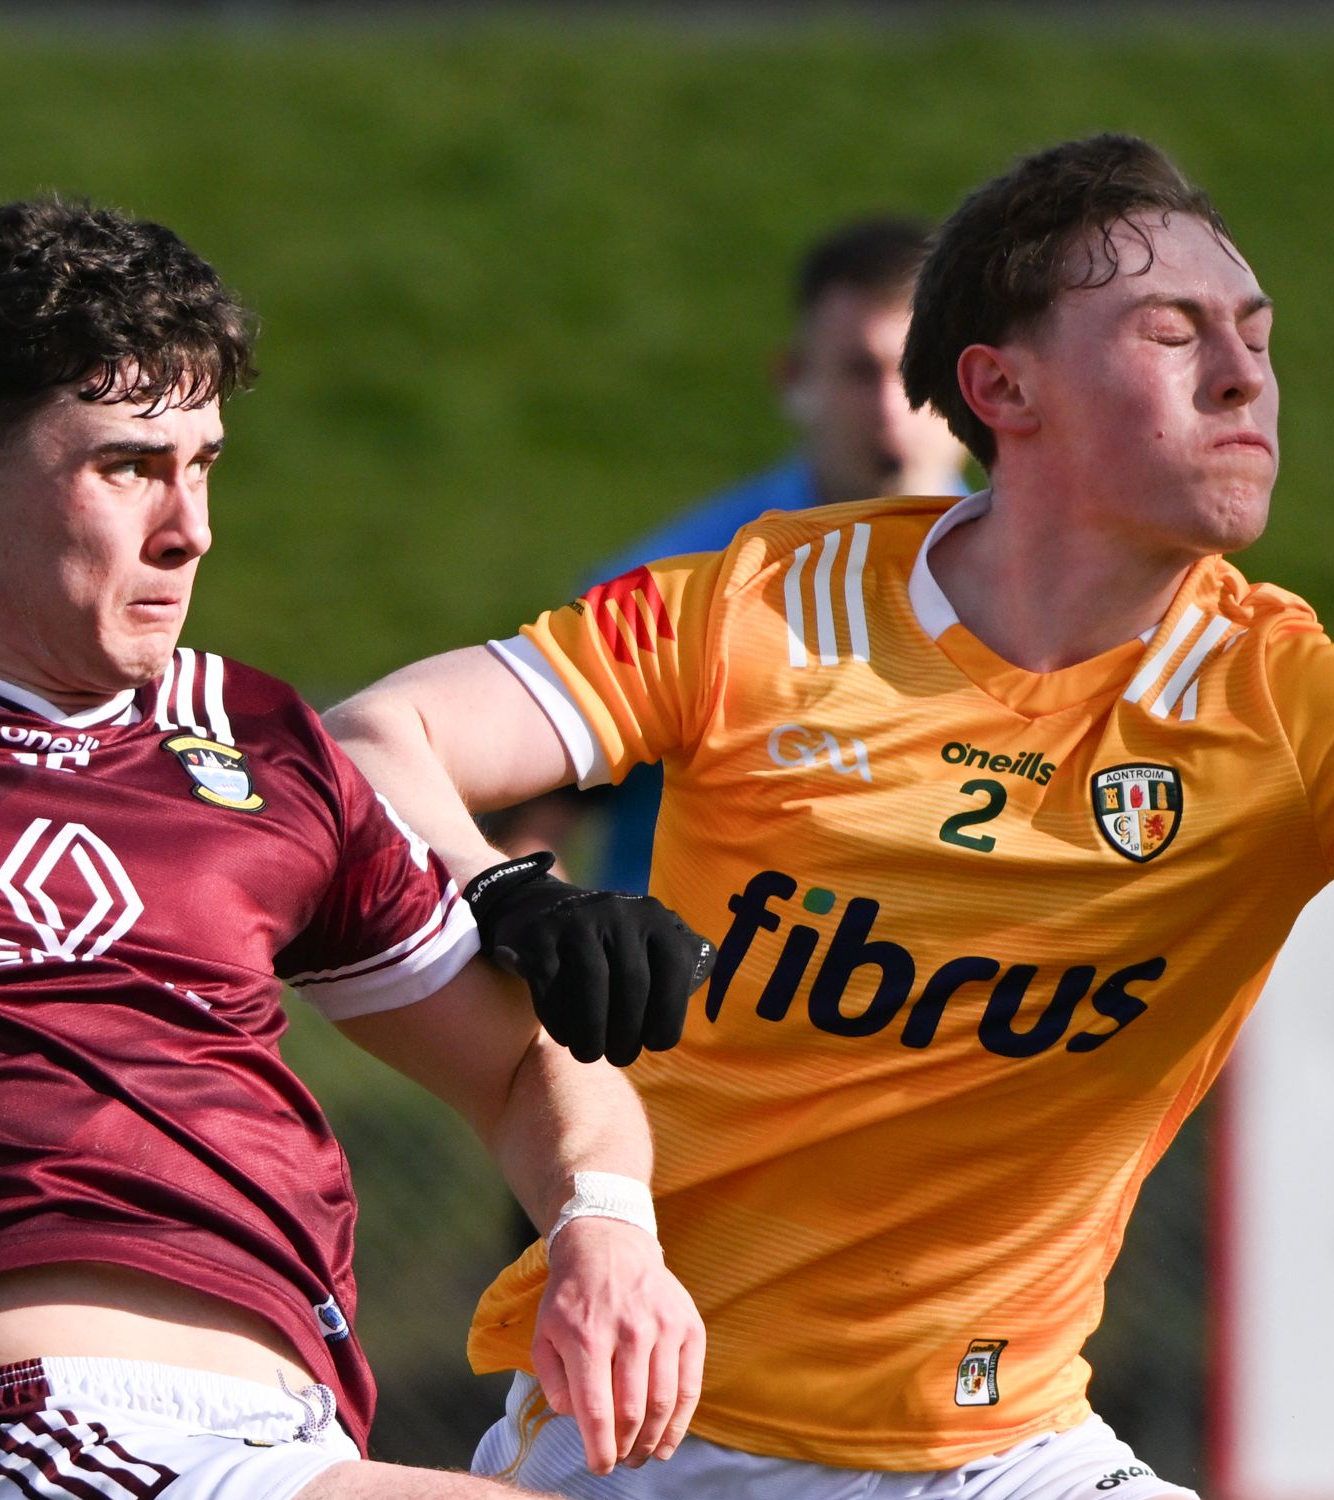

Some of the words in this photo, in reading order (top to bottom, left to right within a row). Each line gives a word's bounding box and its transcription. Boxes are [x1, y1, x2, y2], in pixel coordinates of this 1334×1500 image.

[1106, 769, 1165, 783] AONTROIM
[939, 778, 1007, 853] 2
[705, 870, 1167, 1058] fibrus
